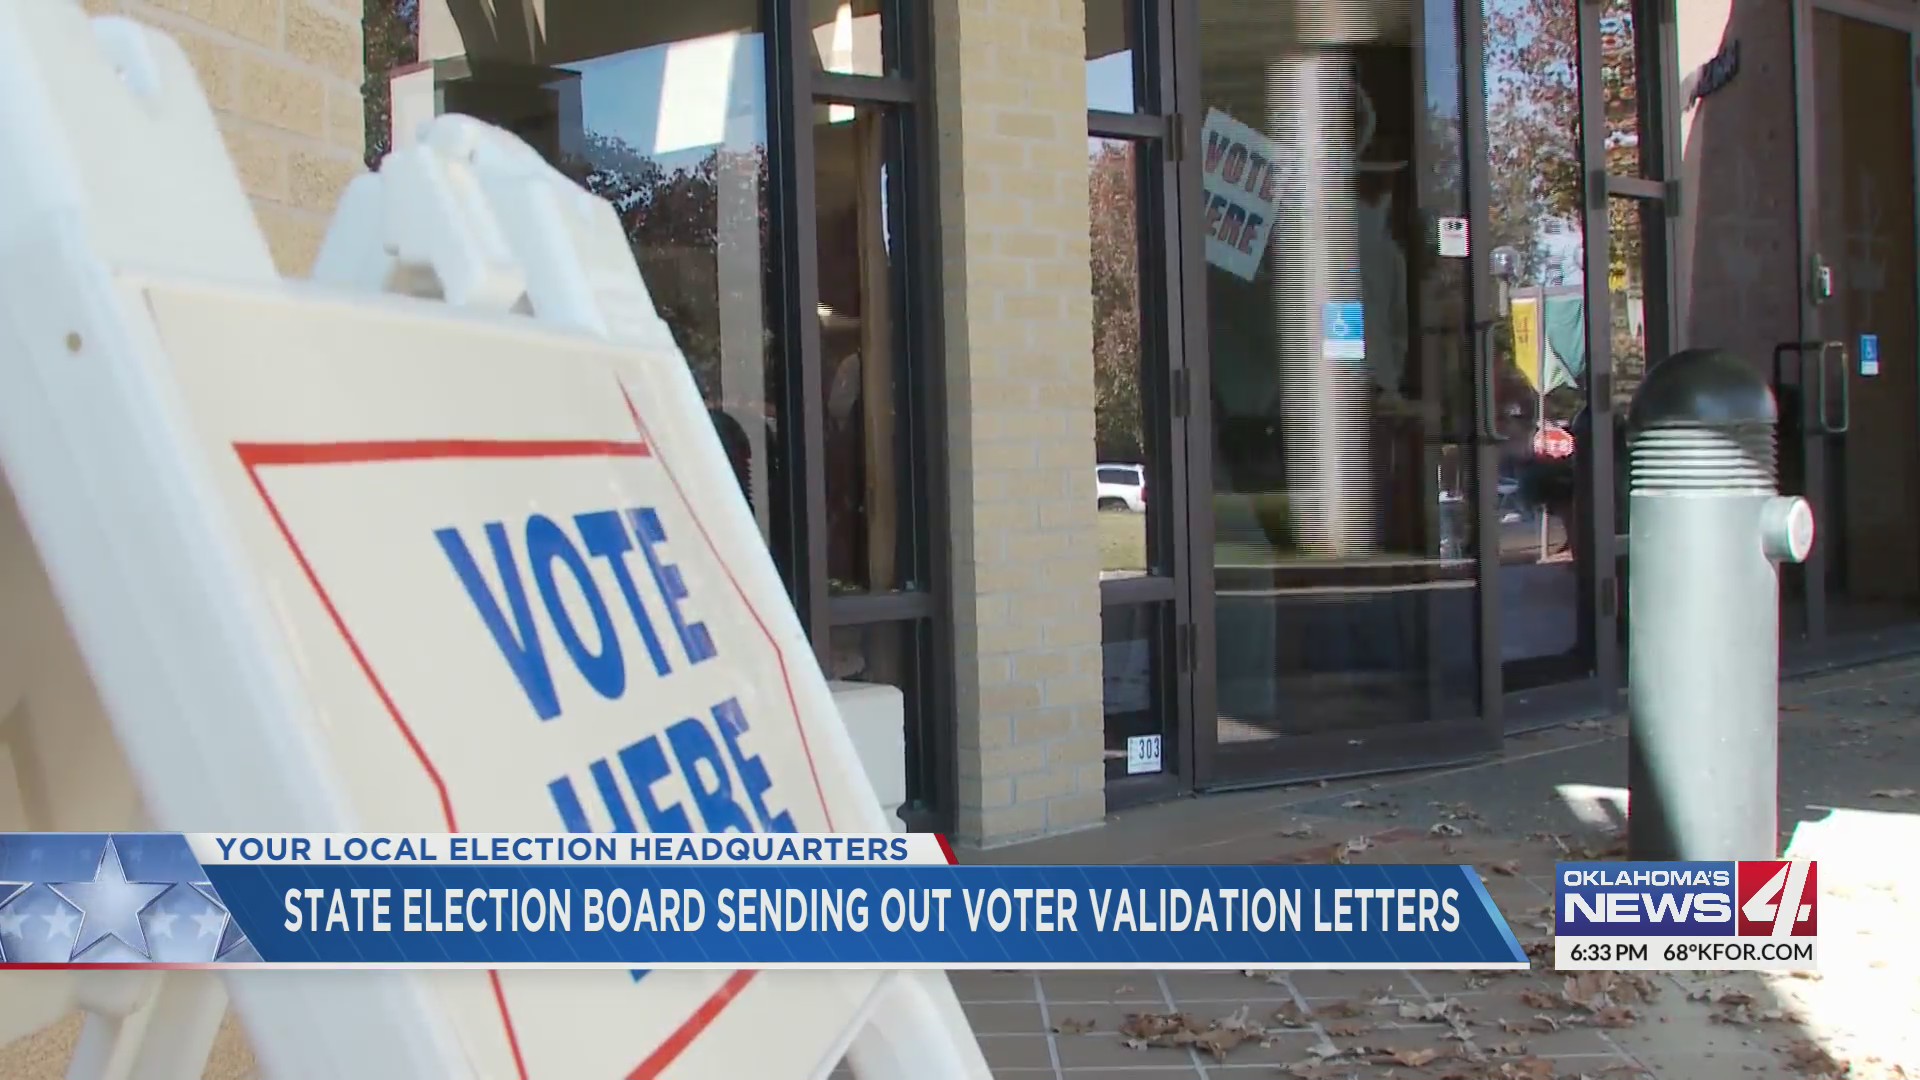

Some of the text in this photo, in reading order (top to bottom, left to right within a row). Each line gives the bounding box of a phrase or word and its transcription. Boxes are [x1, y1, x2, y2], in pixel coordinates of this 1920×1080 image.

[1204, 130, 1282, 202] VOTE
[1203, 189, 1264, 256] ERE
[433, 507, 718, 722] VOTE
[546, 696, 799, 833] ERE
[1138, 736, 1160, 760] 303
